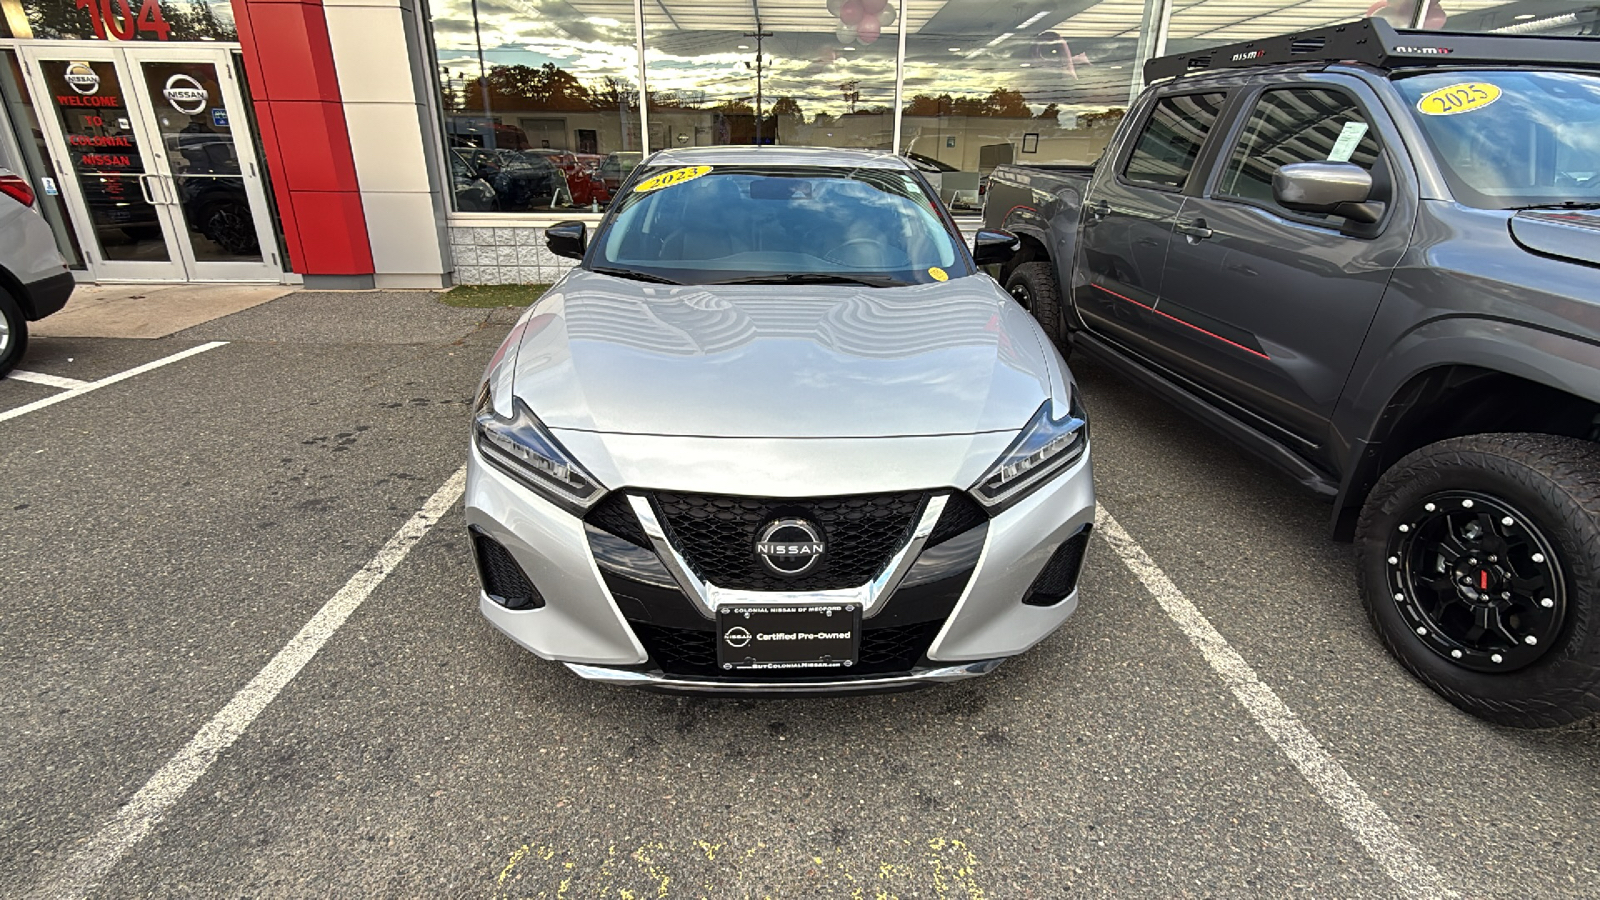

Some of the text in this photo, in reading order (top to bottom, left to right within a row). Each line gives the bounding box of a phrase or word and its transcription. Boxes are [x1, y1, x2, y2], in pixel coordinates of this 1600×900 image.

[76, 0, 171, 41] 104
[57, 95, 118, 107] WELCOME
[167, 91, 204, 99] NISSAN
[1432, 84, 1488, 112] 2025
[84, 115, 103, 126] TO
[69, 135, 132, 147] COLONIAL
[82, 154, 130, 166] NISSAN
[649, 168, 698, 189] 2023
[757, 543, 824, 554] NISSAN
[756, 631, 851, 641] Certified Pre-Owned
